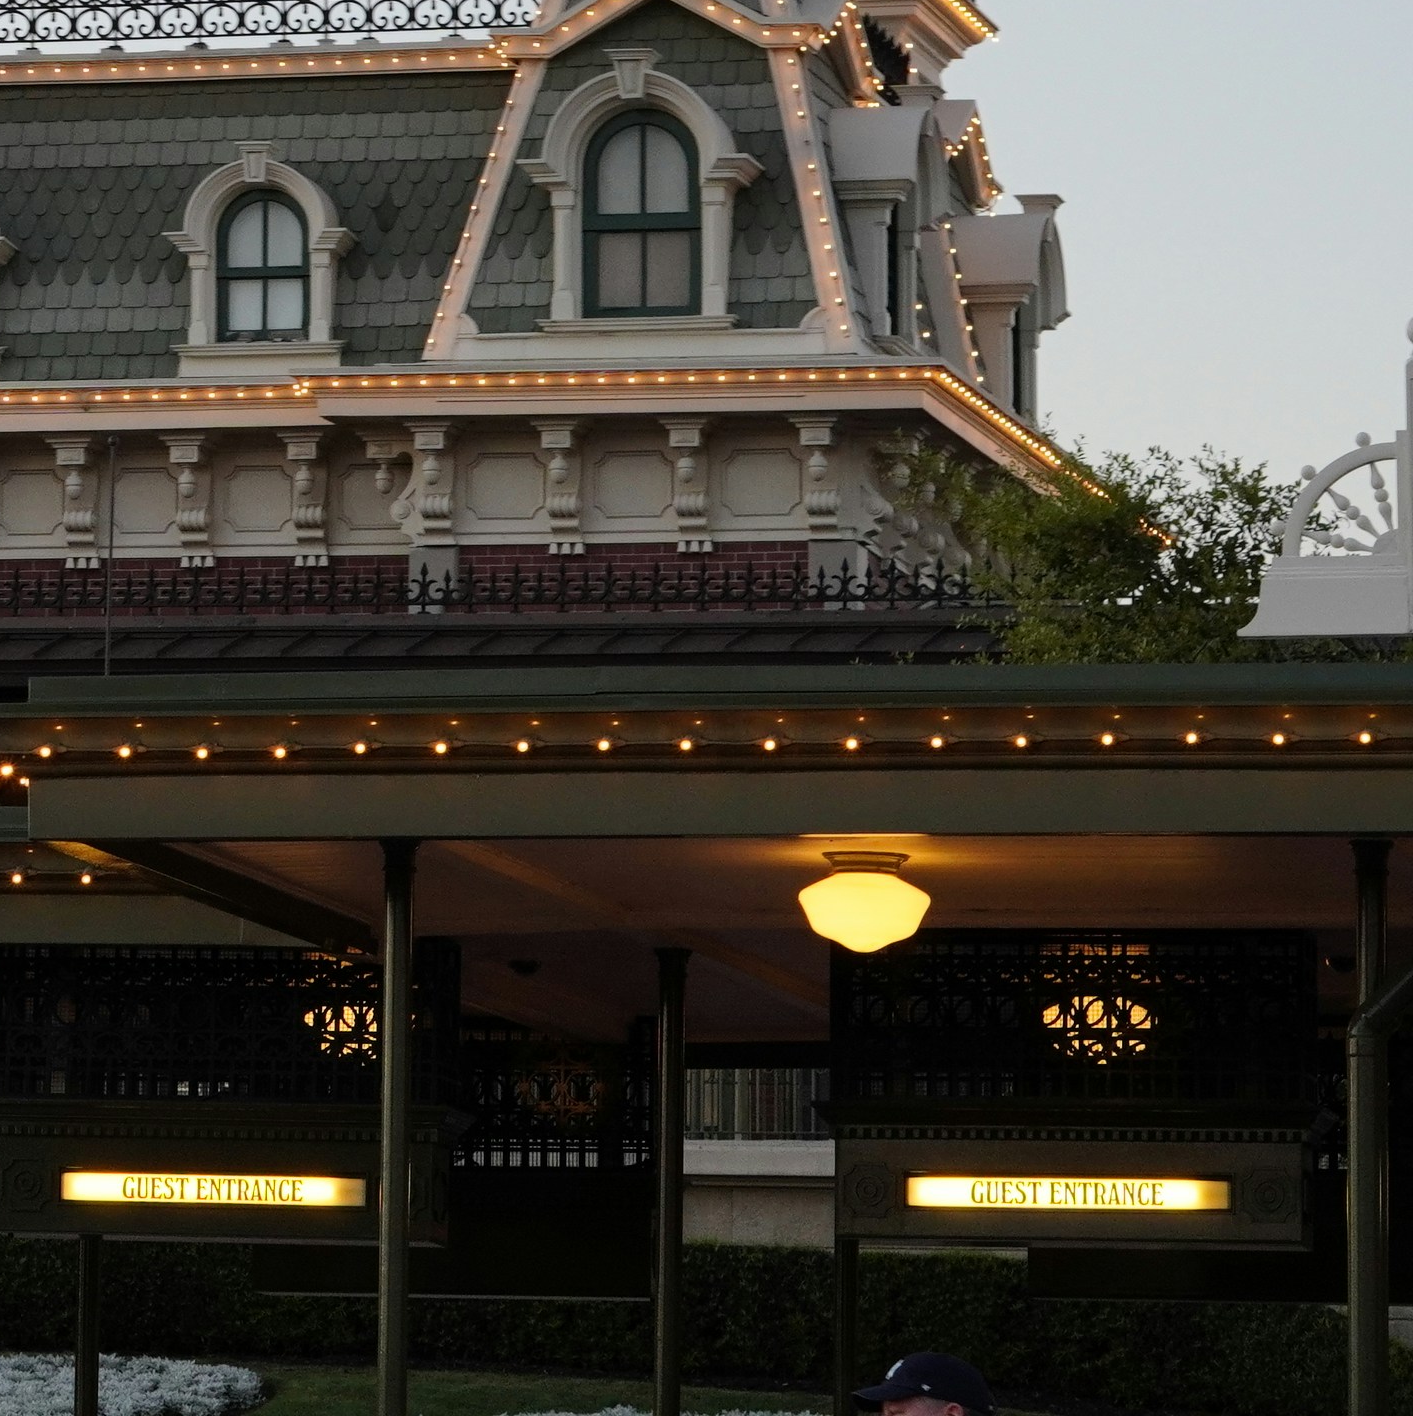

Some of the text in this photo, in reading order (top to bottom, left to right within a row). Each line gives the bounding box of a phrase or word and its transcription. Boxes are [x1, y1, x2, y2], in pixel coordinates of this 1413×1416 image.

[122, 1176, 303, 1202] GUEST ENTRANCE
[971, 1180, 1164, 1206] GUEST ENTRANCE
